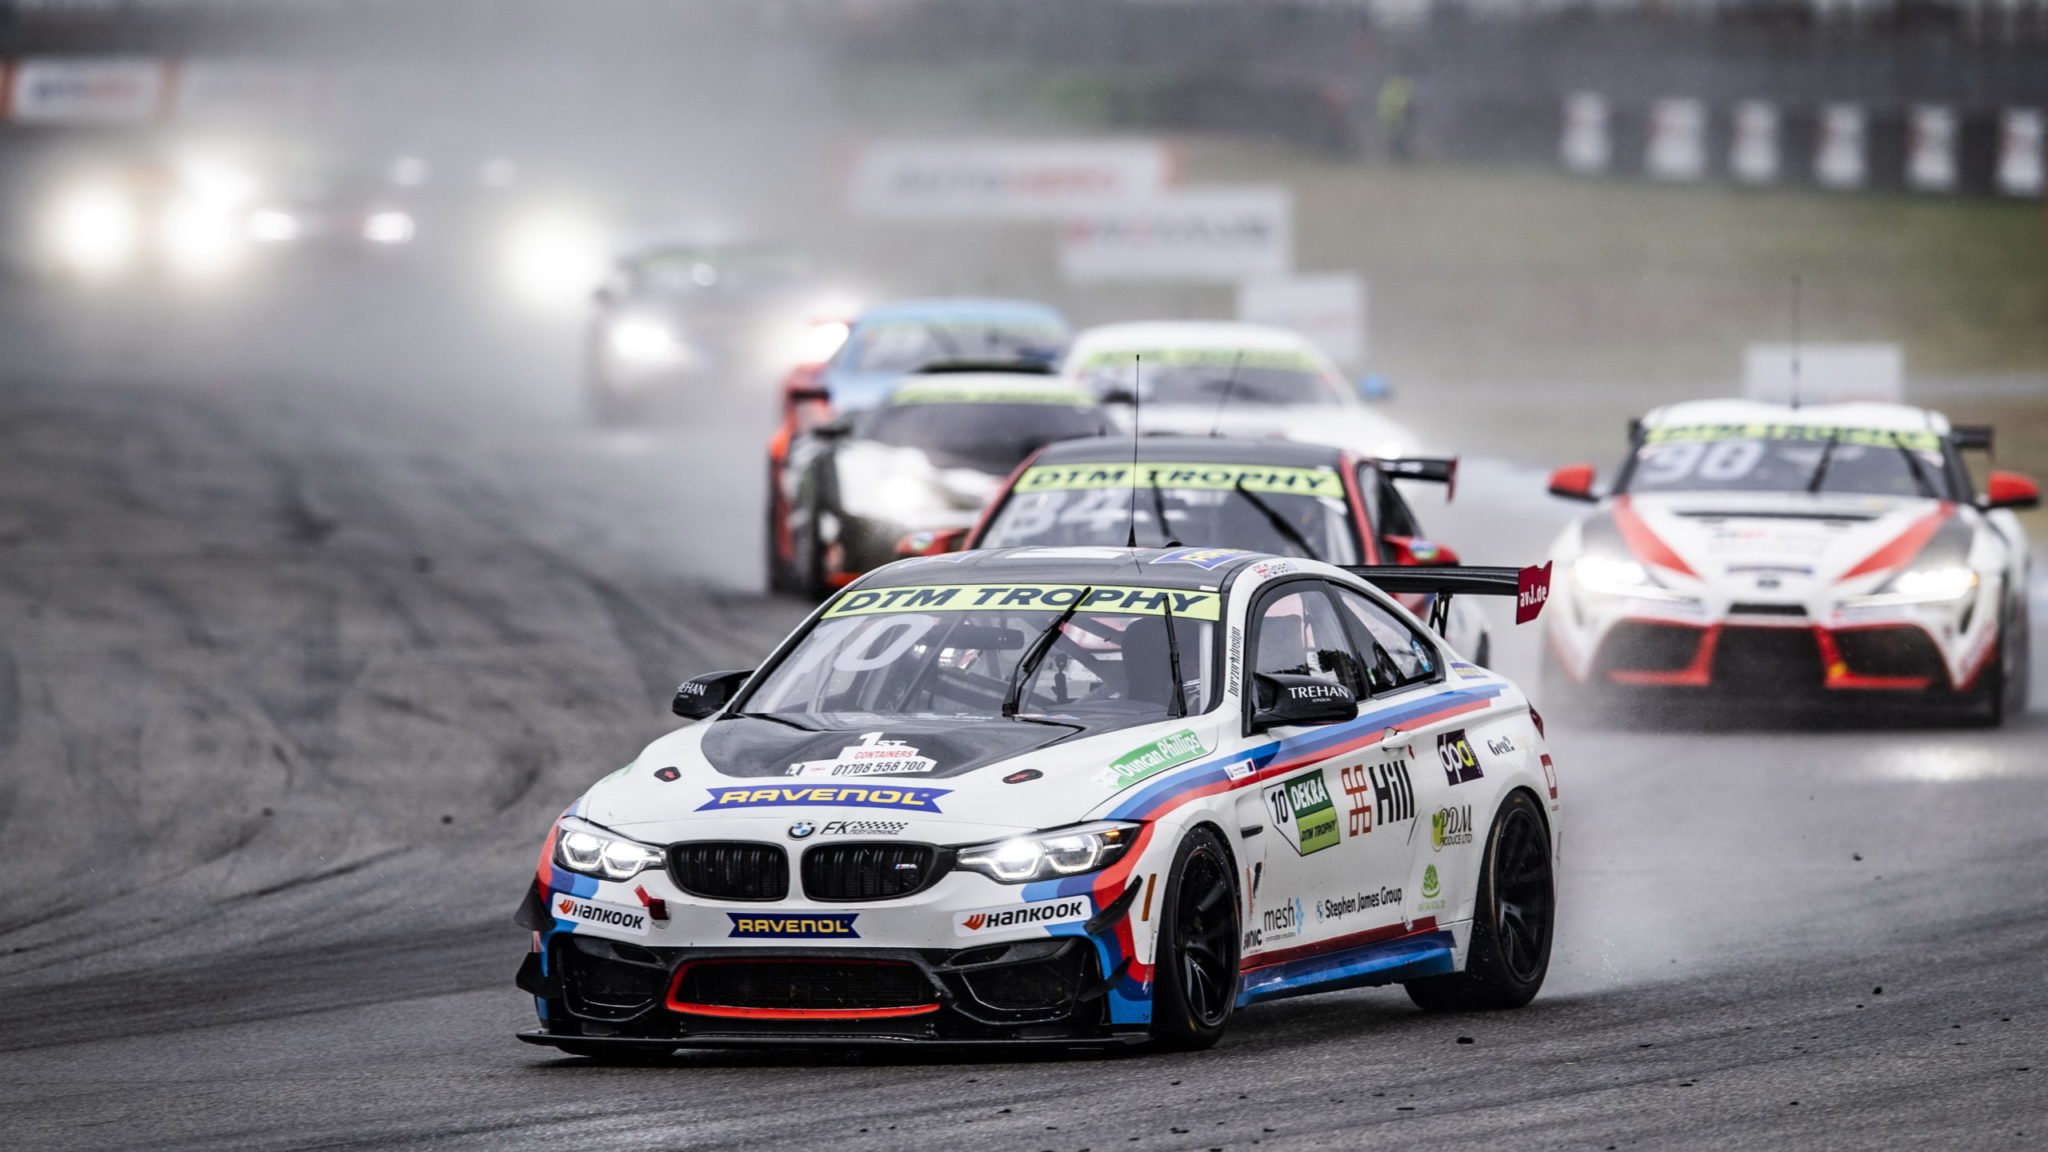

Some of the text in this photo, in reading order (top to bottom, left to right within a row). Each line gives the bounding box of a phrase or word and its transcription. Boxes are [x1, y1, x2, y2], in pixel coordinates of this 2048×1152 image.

[1641, 440, 1765, 481] 90
[1030, 469, 1330, 488] DTM TROPHY
[836, 588, 1211, 613] DTM TROPHY
[796, 613, 936, 674] 10
[1288, 686, 1349, 699] TREHAN
[832, 763, 872, 776] 01708
[873, 761, 900, 773] 558
[901, 761, 926, 771] 700
[854, 750, 914, 760] CONTAINERS
[1113, 750, 1162, 777] Duncan
[1157, 733, 1199, 760] Phillips
[1439, 734, 1475, 783] dpa
[718, 788, 927, 806] RAVENOL
[1271, 789, 1289, 825] 10
[1290, 777, 1328, 811] DEKRA
[1369, 759, 1415, 826] Hill
[820, 821, 855, 835] FK
[1301, 820, 1337, 842] DTM TROPHY
[1440, 804, 1472, 835] PDM
[1264, 898, 1295, 933] mesh
[1325, 886, 1402, 919] Stephen James Group
[737, 919, 849, 933] RAVENOL
